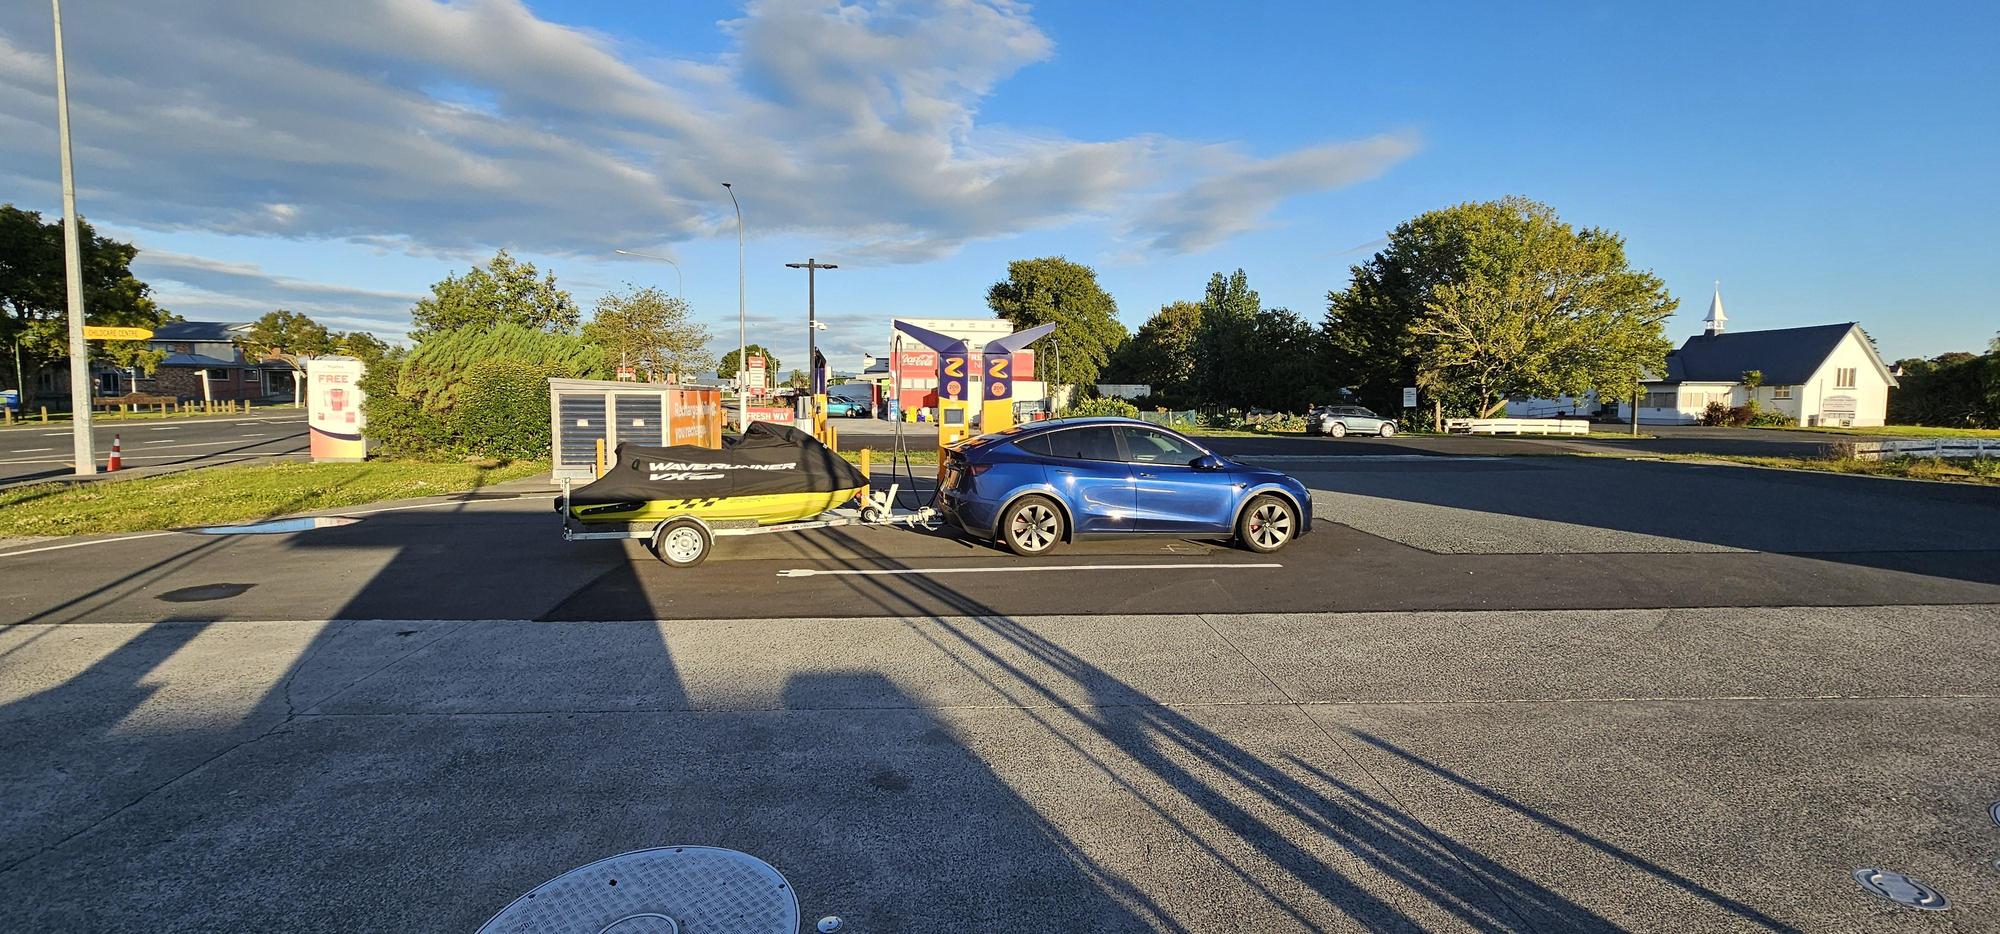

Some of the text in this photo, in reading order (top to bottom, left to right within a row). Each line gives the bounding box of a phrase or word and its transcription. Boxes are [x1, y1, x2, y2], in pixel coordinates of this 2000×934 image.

[88, 329, 138, 337] CHILDCARE CENTRE
[318, 374, 349, 383] FREE
[746, 412, 789, 421] FRESH WAY
